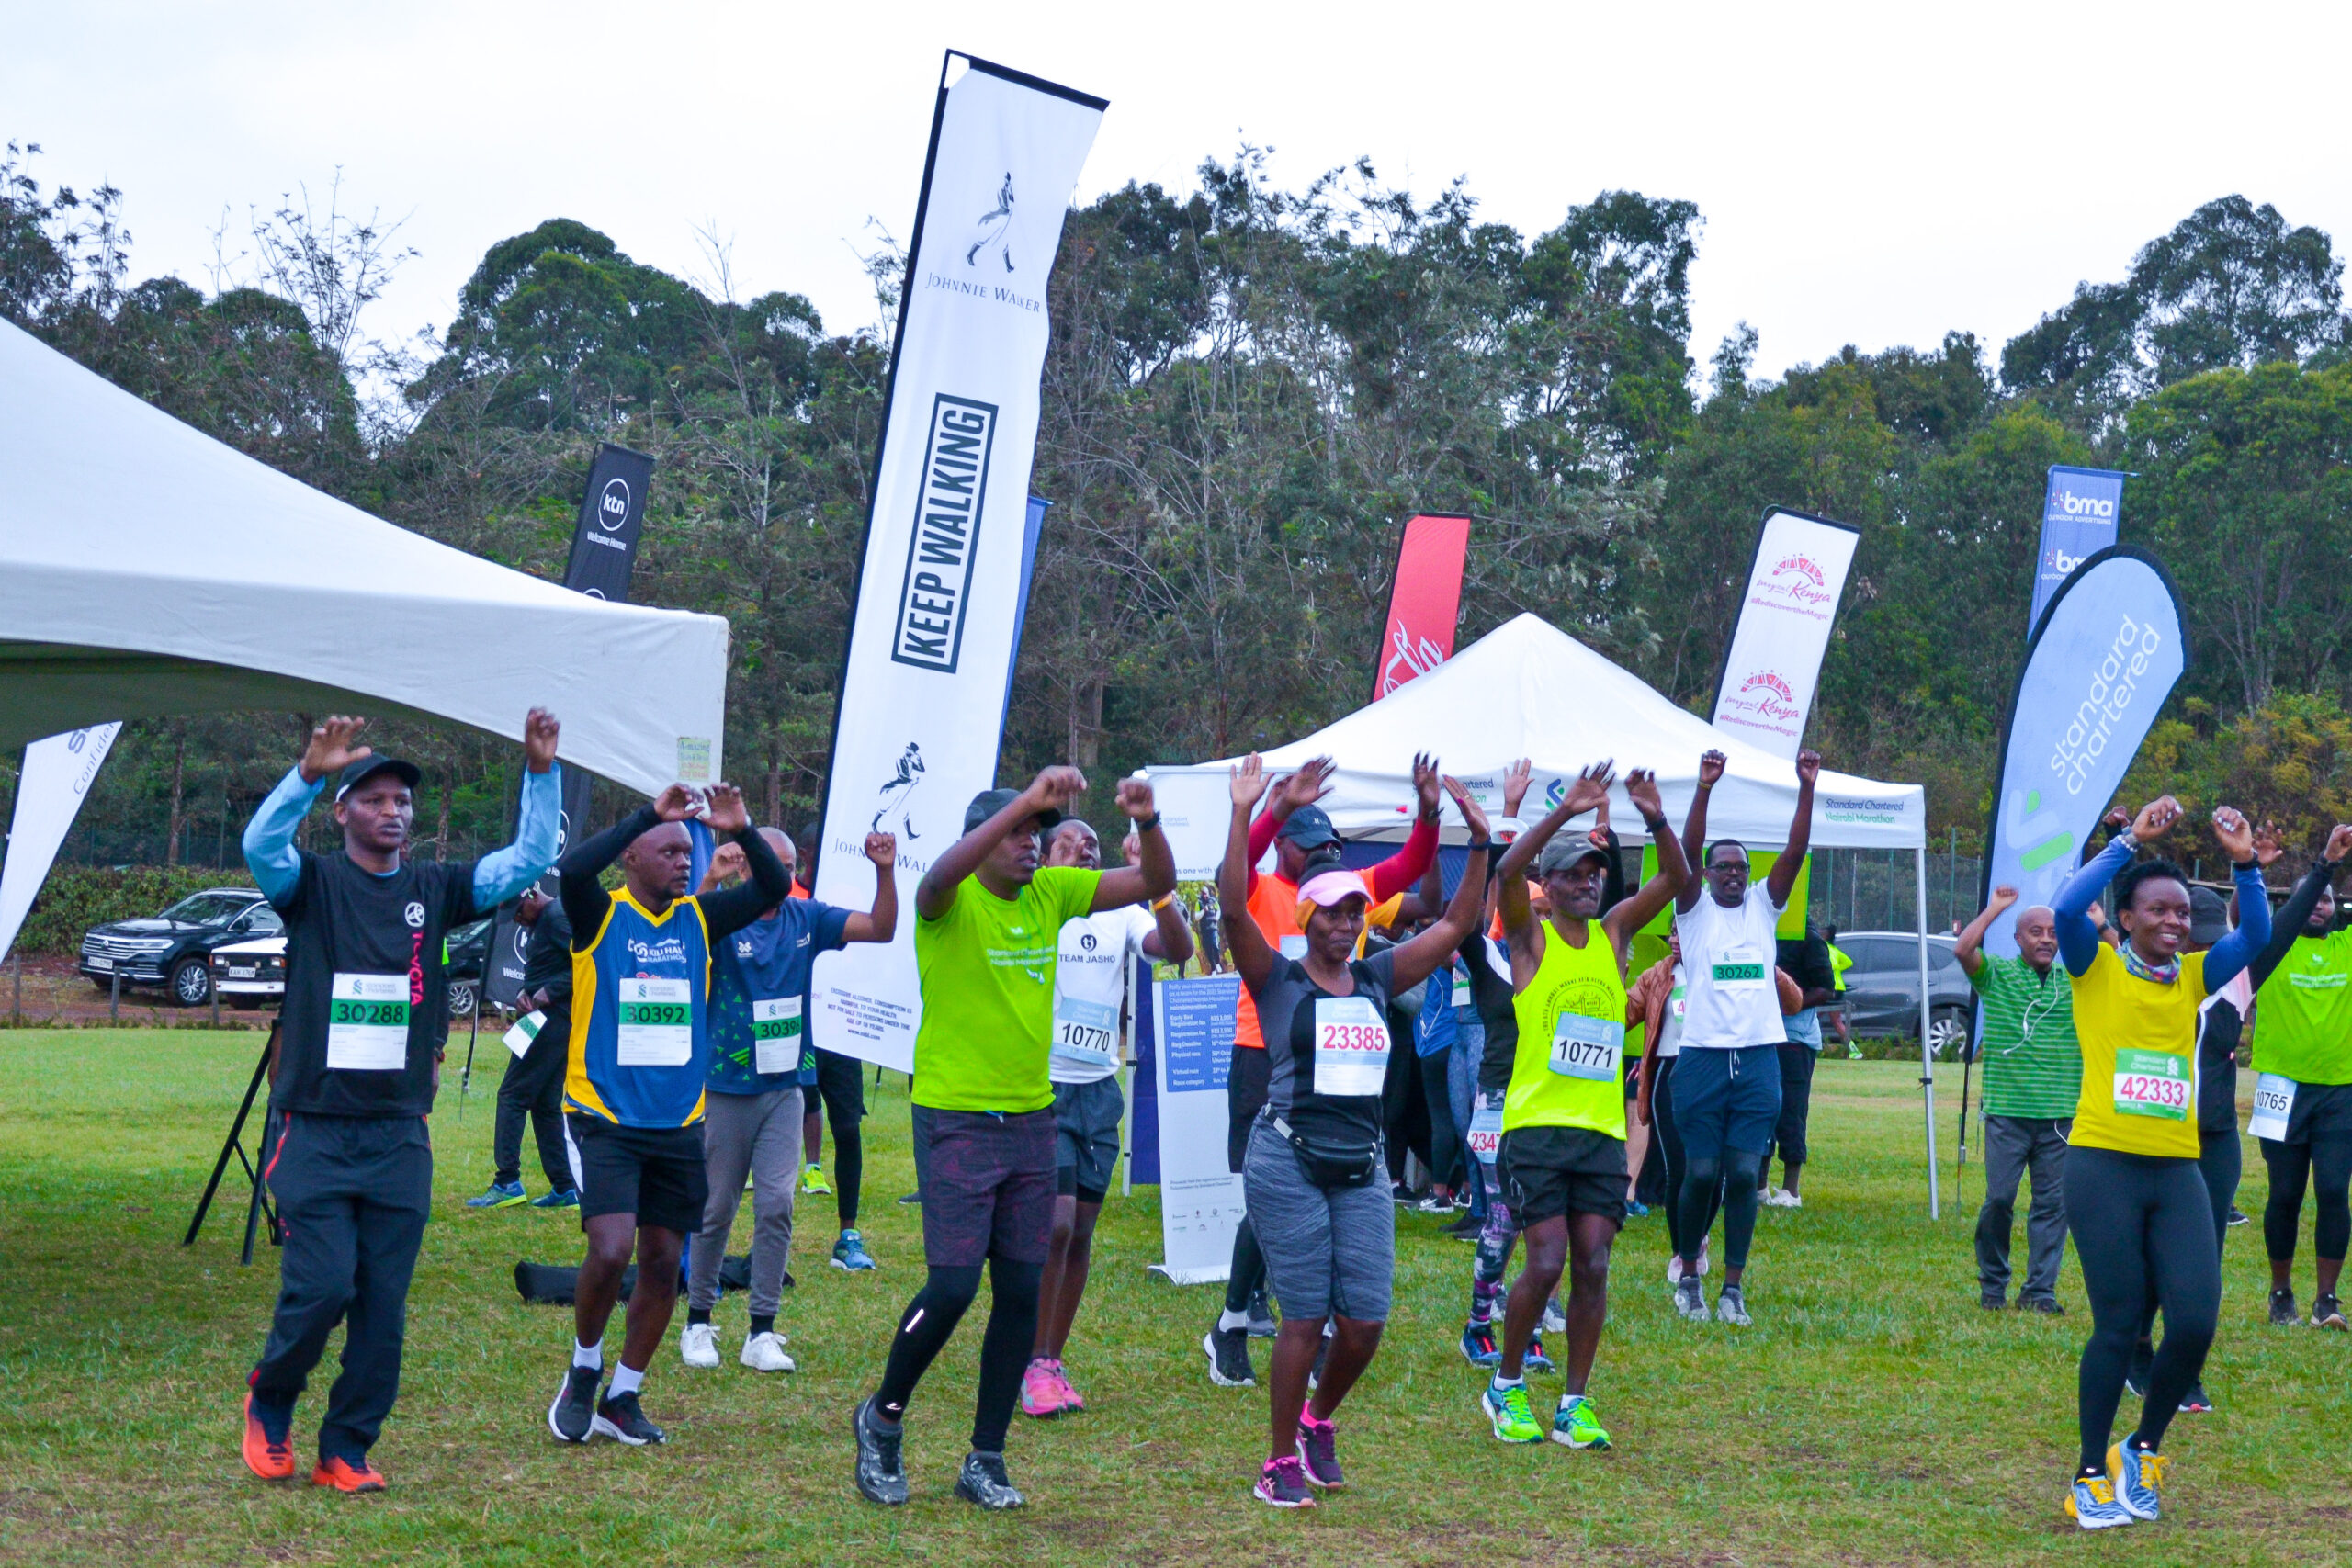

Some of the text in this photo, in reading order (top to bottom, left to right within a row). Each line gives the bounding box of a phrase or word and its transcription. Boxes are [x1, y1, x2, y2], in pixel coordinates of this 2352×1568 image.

[924, 272, 1041, 314] JOHNNIE WALKER
[603, 493, 626, 515] ktn
[2064, 491, 2114, 518] bma
[2074, 514, 2112, 525] ADVERTISING
[904, 409, 986, 660] KEEP WALKING
[2056, 548, 2087, 574] bm
[1788, 581, 1832, 604] Kenya
[2050, 613, 2140, 778] standard
[1757, 697, 1801, 721] Kenya
[2066, 622, 2162, 795] chartered
[1825, 797, 1905, 811] Standard Chartered
[1825, 811, 1895, 824] Nairobi Marathon
[832, 837, 927, 874] JOHN WAL
[1058, 953, 1116, 964] TEAM JASHO
[503, 967, 526, 981] Welco
[1716, 965, 1761, 979] 30262
[337, 1002, 404, 1024] 30288
[626, 1005, 685, 1023] 30392
[1062, 1022, 1110, 1052] 10770
[1322, 1025, 1385, 1051] 23385
[1559, 1039, 1613, 1068] 10771
[2120, 1076, 2184, 1106] 42333
[2256, 1090, 2289, 1111] 10765
[1472, 1132, 1501, 1152] 234
